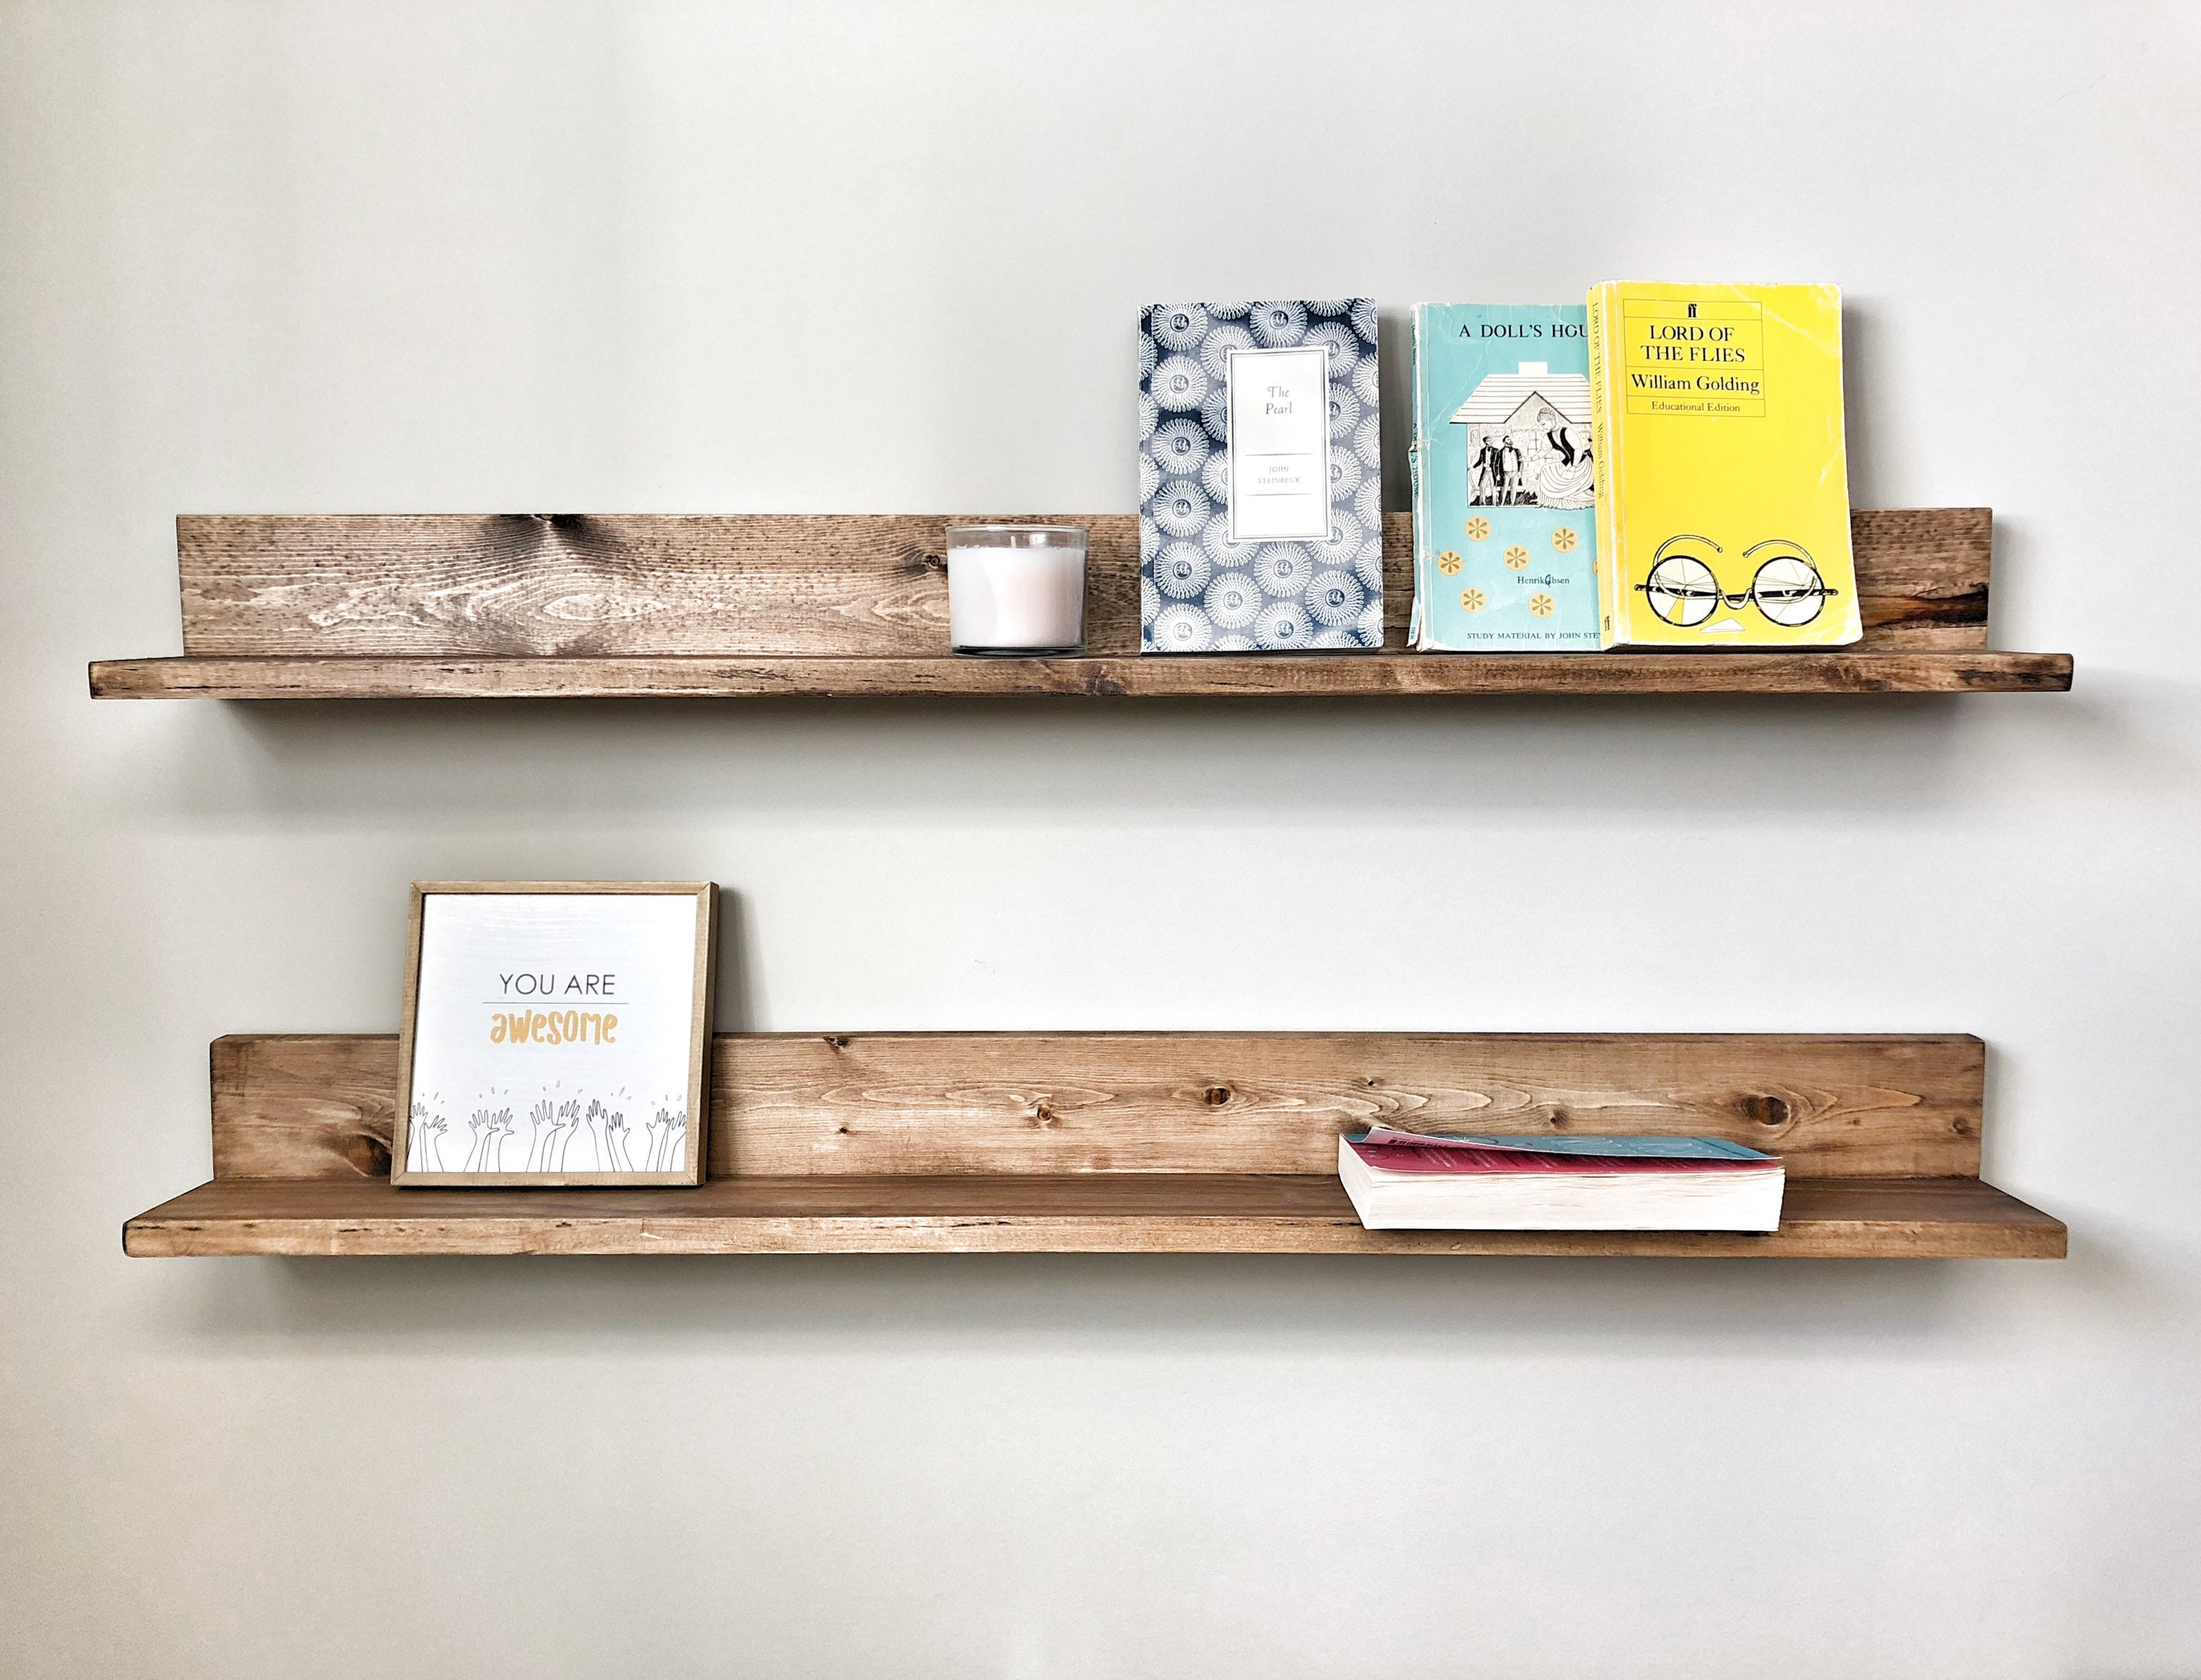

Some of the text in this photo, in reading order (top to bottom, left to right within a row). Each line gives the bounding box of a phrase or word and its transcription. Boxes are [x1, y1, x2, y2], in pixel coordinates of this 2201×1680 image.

[1459, 324, 1588, 338] A DOLL'S HOU
[1650, 325, 1735, 342] LORD OF
[1594, 336, 1600, 348] OF
[1640, 345, 1745, 362] THE FLIES
[1631, 373, 1760, 395] William Golding
[1268, 386, 1290, 398] The
[1266, 401, 1292, 414] Pearl
[1651, 401, 1740, 412] Educational Edition
[1269, 466, 1289, 474] JOHN
[1517, 576, 1544, 584] Henrik
[499, 974, 616, 995] YOU ARE
[490, 1009, 618, 1045] awesome
